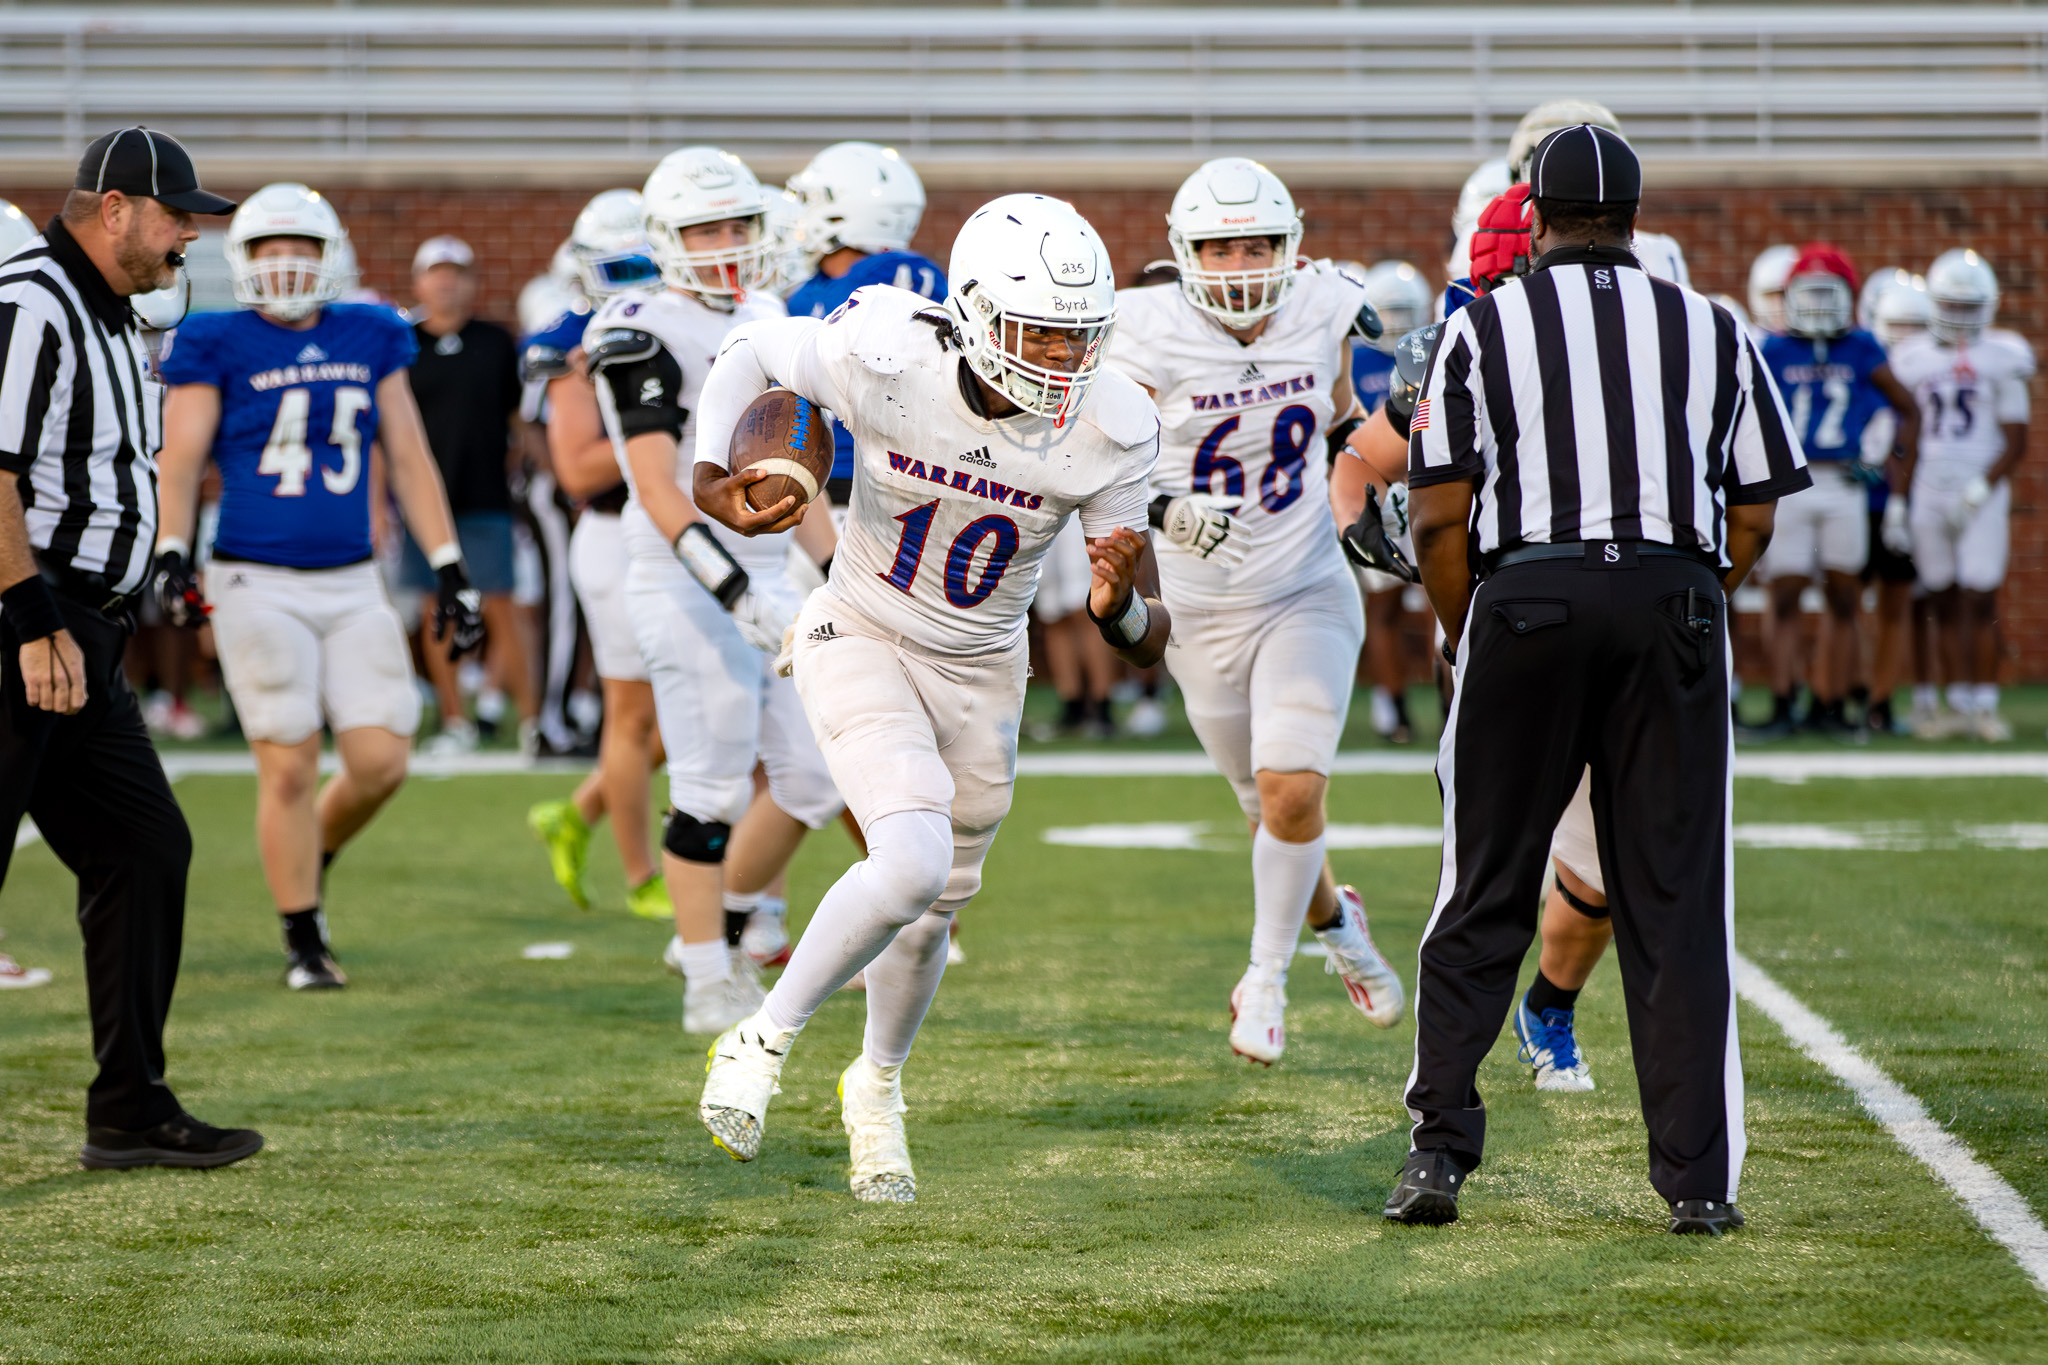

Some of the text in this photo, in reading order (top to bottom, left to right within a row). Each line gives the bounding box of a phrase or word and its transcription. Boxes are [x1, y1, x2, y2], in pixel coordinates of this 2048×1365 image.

[1061, 262, 1085, 275] 235
[1052, 296, 1088, 313] Byrd
[1191, 373, 1315, 411] WARHAWKS
[257, 386, 373, 497] 45
[1191, 404, 1317, 515] 68
[958, 453, 998, 470] adidas
[887, 451, 1045, 511] WARHAWKS
[875, 498, 1020, 609] 10
[1604, 543, 1620, 562] S
